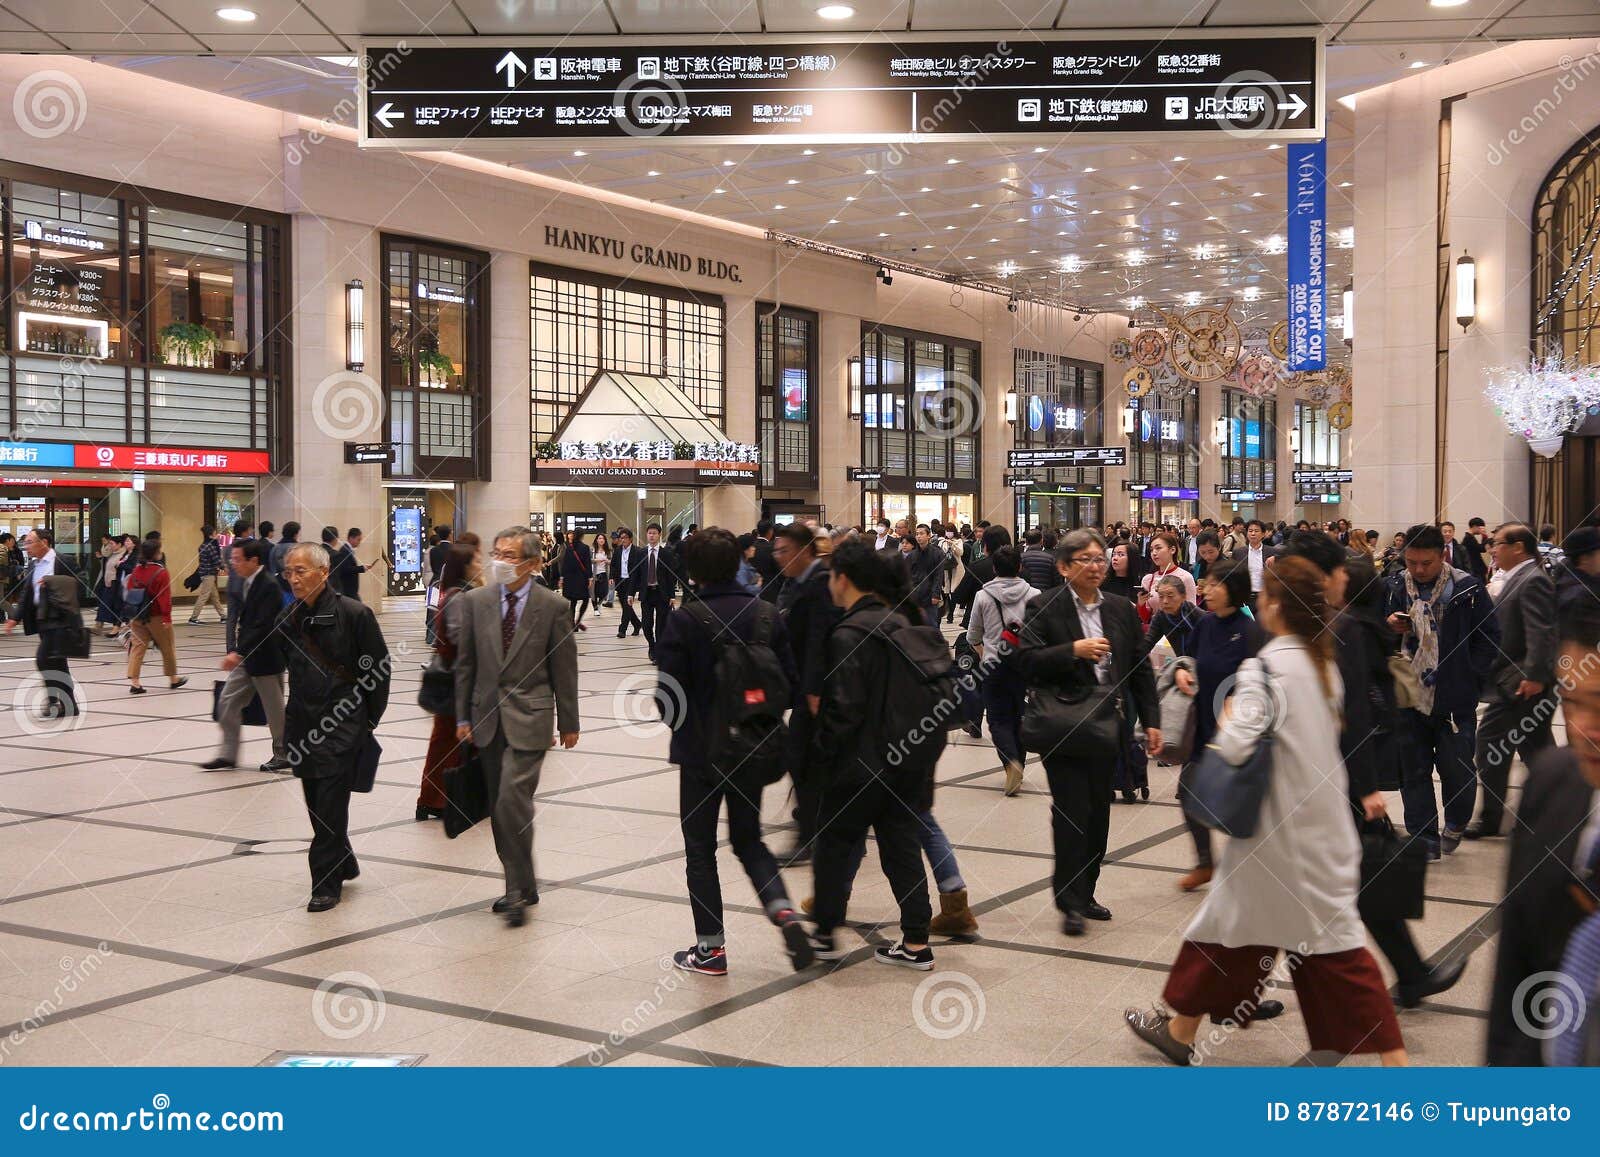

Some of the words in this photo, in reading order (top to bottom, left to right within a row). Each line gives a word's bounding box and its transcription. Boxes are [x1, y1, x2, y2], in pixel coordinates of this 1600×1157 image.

[561, 58, 621, 72] 阪神電車
[890, 58, 956, 71] 梅田阪急ビル
[959, 57, 1037, 69] オフィスタワー
[1053, 56, 1141, 68] 阪急グランドビル
[1158, 54, 1221, 67] 阪急32番街
[587, 73, 601, 81] Rwy.
[664, 73, 688, 81] Subway
[638, 105, 732, 117] TOHOシネマズ梅田
[1049, 98, 1148, 114] 地下鉄(御堂筋線)
[1195, 96, 1265, 112] JR大阪駅
[416, 107, 480, 119] HEPファイブ
[491, 107, 545, 118] HEPナビオ
[556, 105, 626, 118] 阪急メンズ大阪
[1298, 153, 1314, 214] VOGUE
[44, 233, 104, 250] CORRIDOR
[544, 225, 624, 260] HANKYU
[631, 244, 692, 272] GRAND
[697, 257, 743, 283] BLDG.
[35, 264, 63, 274] コーヒー
[34, 275, 55, 285] ビール
[32, 287, 71, 298] グラスワイン
[1296, 284, 1307, 313] 2016
[1310, 289, 1321, 330] NIGHT
[1295, 317, 1307, 365] OSAKA
[1310, 334, 1321, 361] OUT
[561, 439, 675, 461] 阪急32番街
[694, 441, 760, 463] 阪急32番街
[134, 451, 228, 468] 三菱東京UFJ銀行
[569, 468, 604, 476] HANKYU
[608, 468, 639, 476] GRAND
[641, 468, 666, 476] BLDG.
[740, 470, 754, 478] BLDG.
